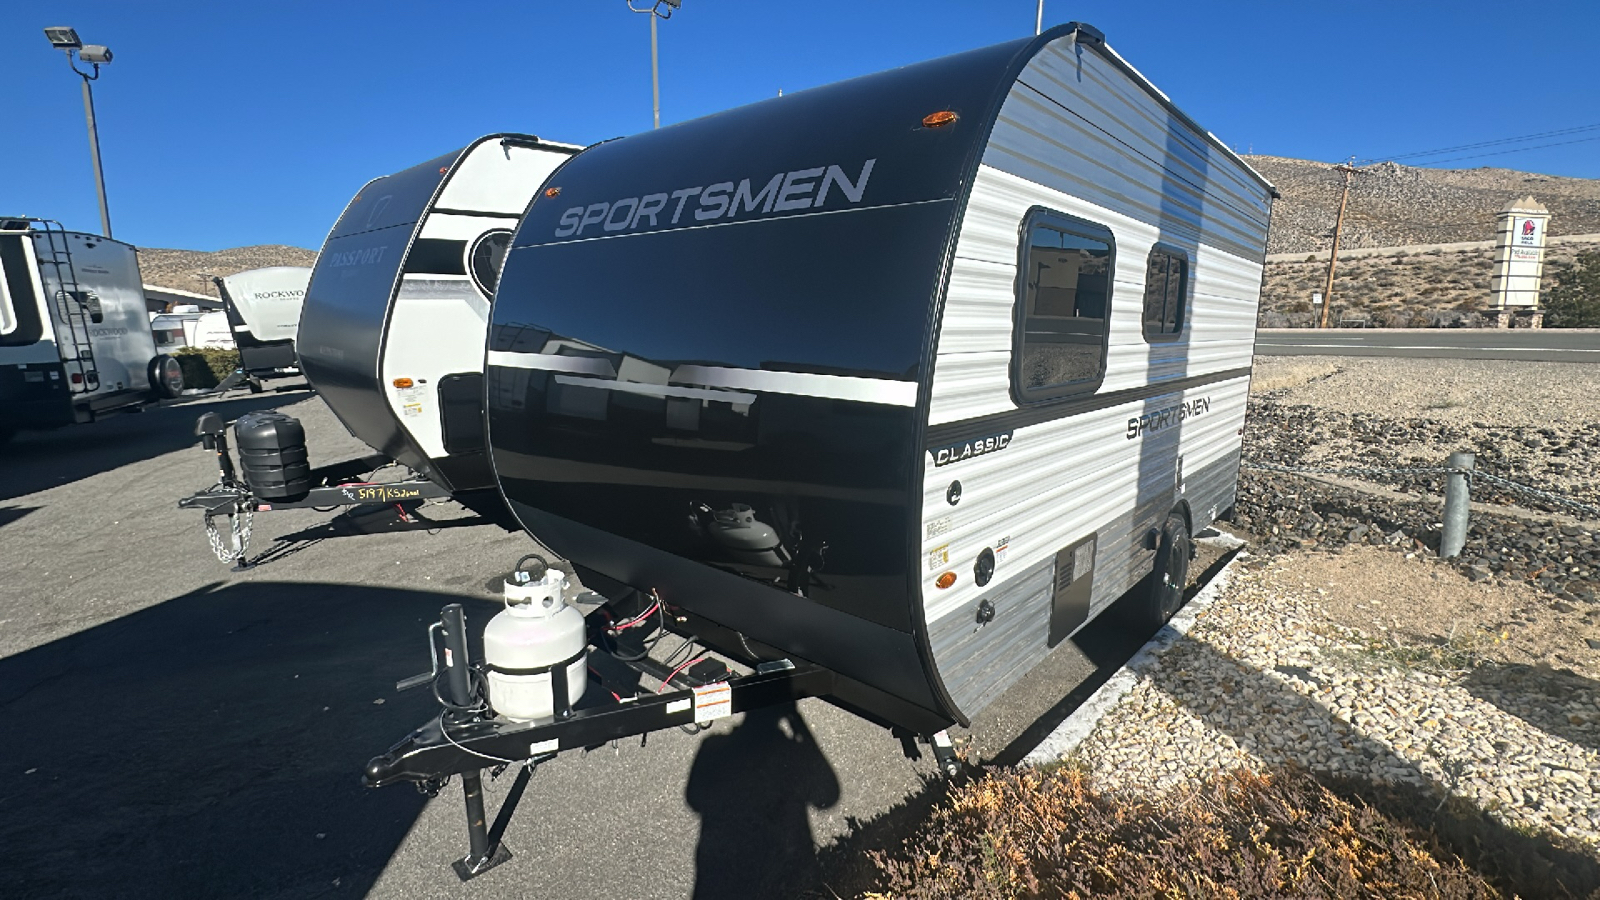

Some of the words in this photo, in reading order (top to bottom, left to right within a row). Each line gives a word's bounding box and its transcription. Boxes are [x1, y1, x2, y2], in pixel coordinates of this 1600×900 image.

[555, 158, 877, 238] SPORTSMEN
[329, 246, 388, 268] PASSPORT
[1126, 396, 1211, 440] SPORTSMEN
[936, 434, 1009, 465] CLASSIC
